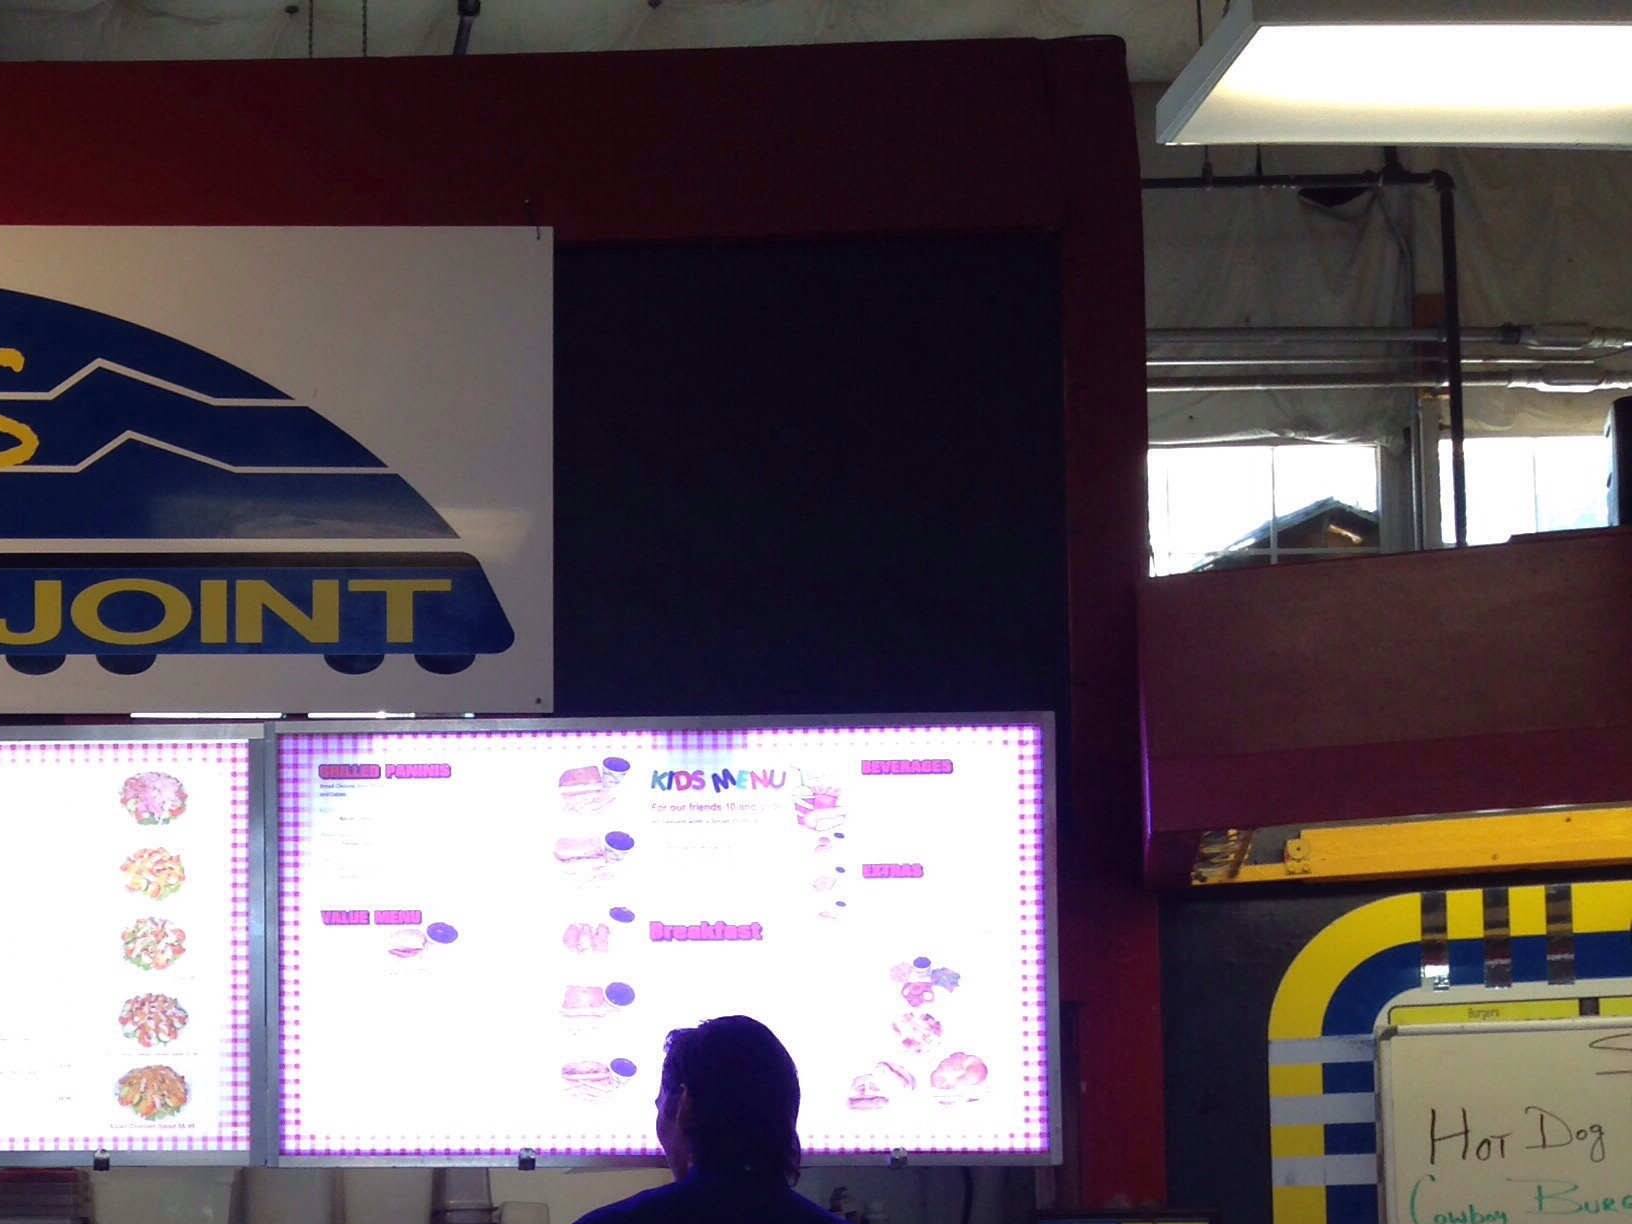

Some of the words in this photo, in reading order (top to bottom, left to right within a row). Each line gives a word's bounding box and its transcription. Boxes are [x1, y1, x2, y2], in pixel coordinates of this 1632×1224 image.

[651, 769, 706, 792] KIDS
[711, 768, 787, 794] MENU
[649, 920, 763, 942] Breakfast
